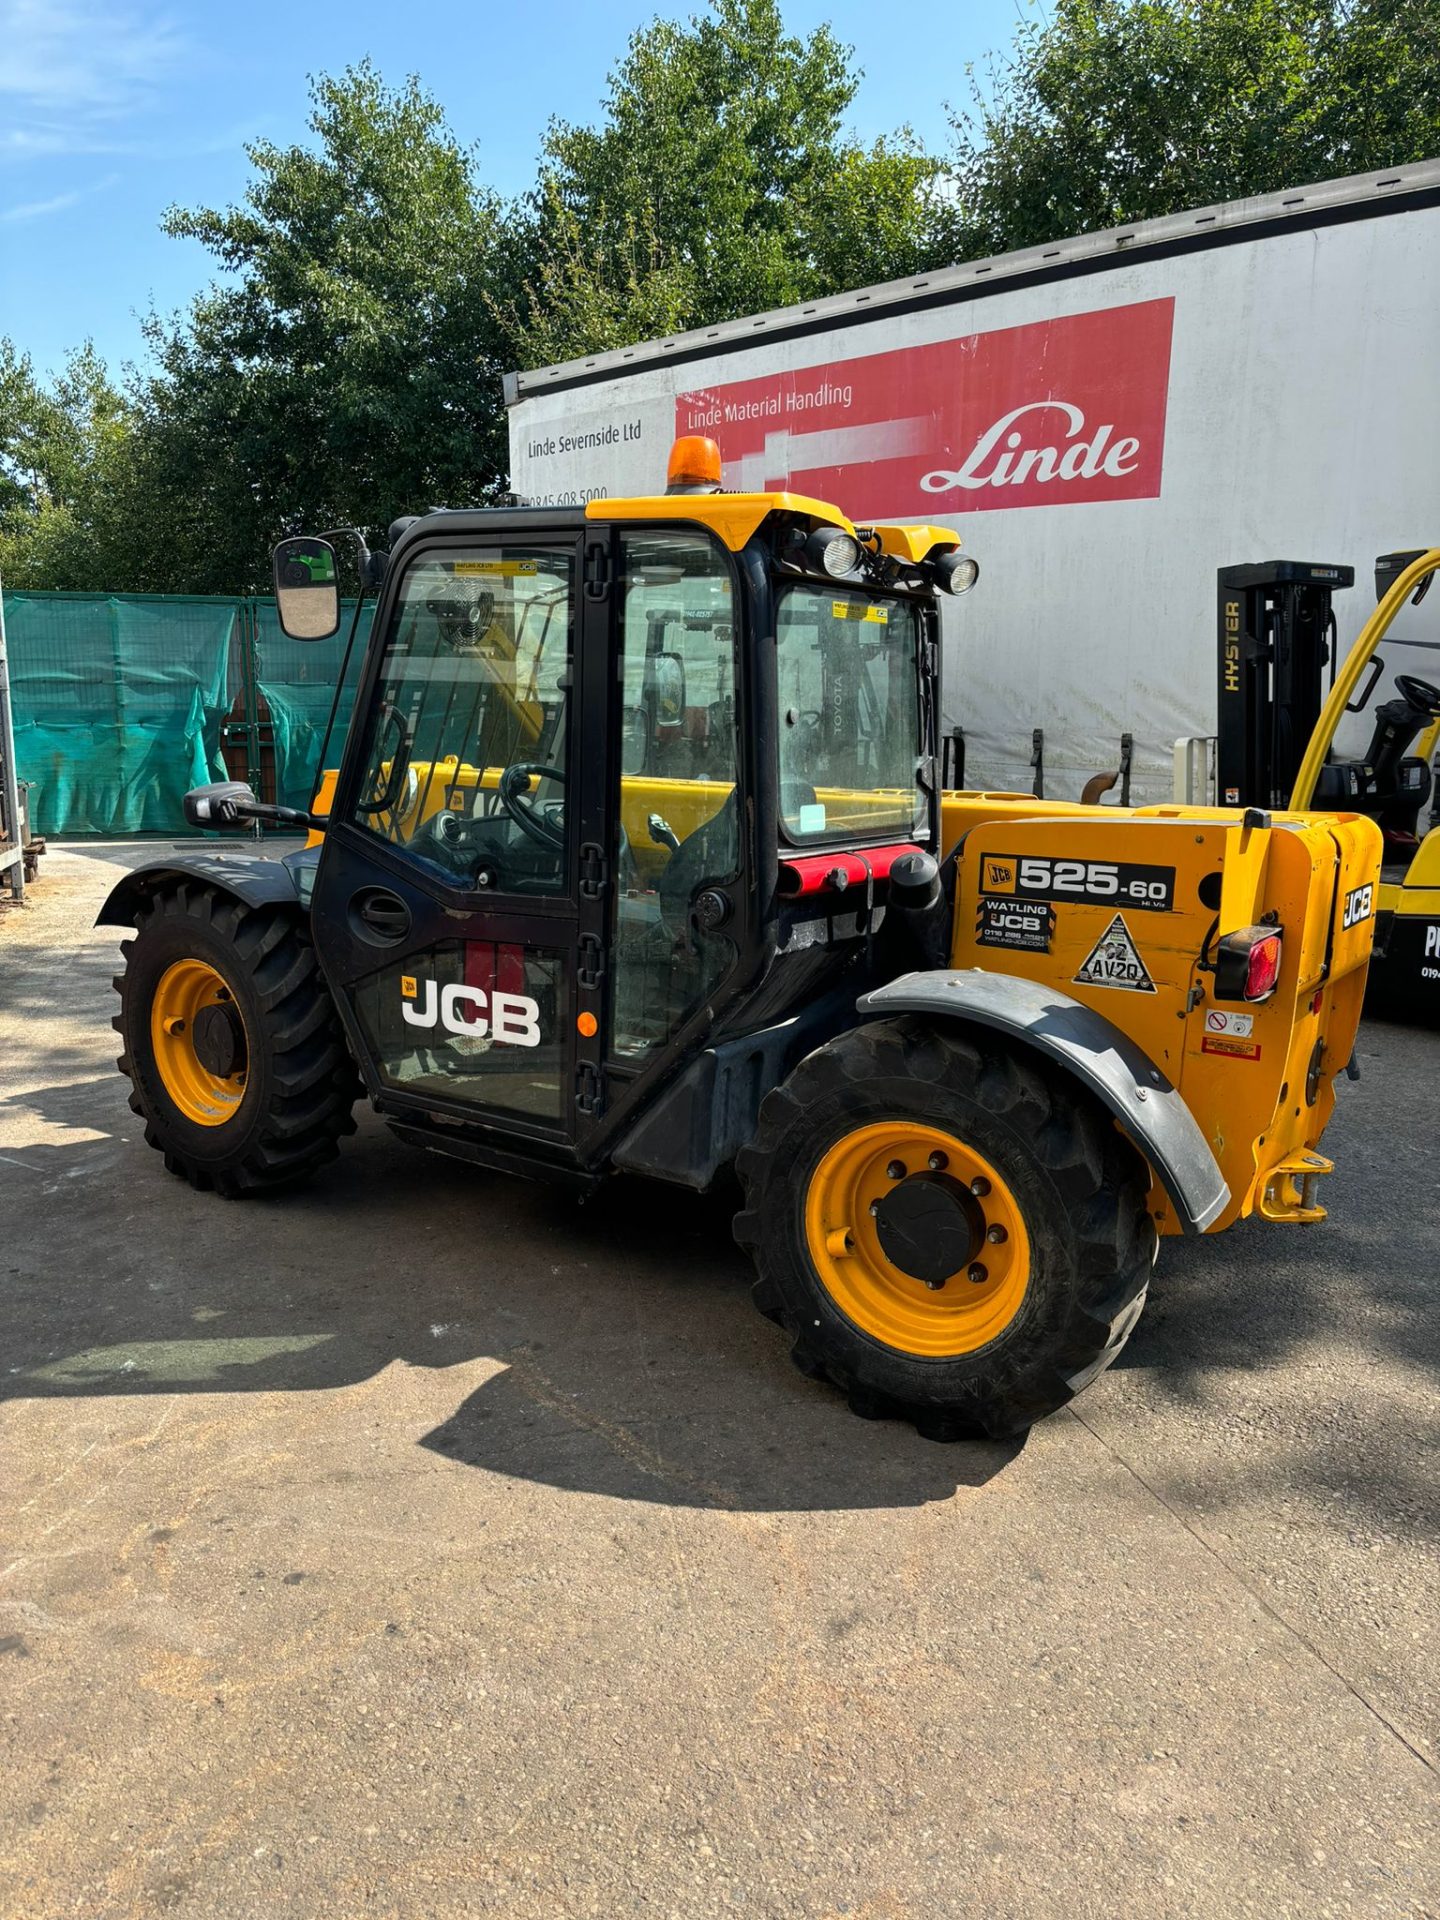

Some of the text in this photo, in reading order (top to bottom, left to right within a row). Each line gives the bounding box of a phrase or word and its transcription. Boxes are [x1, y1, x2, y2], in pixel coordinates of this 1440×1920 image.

[688, 384, 852, 430] Linde Material Handling
[528, 419, 641, 459] Linde Severnside Ltd
[919, 400, 1140, 493] Linde
[1225, 602, 1239, 692] HYSTER
[833, 676, 842, 735] TOYOTA
[991, 866, 1011, 883] JCB
[1019, 859, 1167, 900] 525-60
[986, 900, 1048, 915] WATLING
[990, 914, 1041, 931] JCB
[1343, 885, 1373, 928] JCB
[401, 979, 541, 1048] JCB
